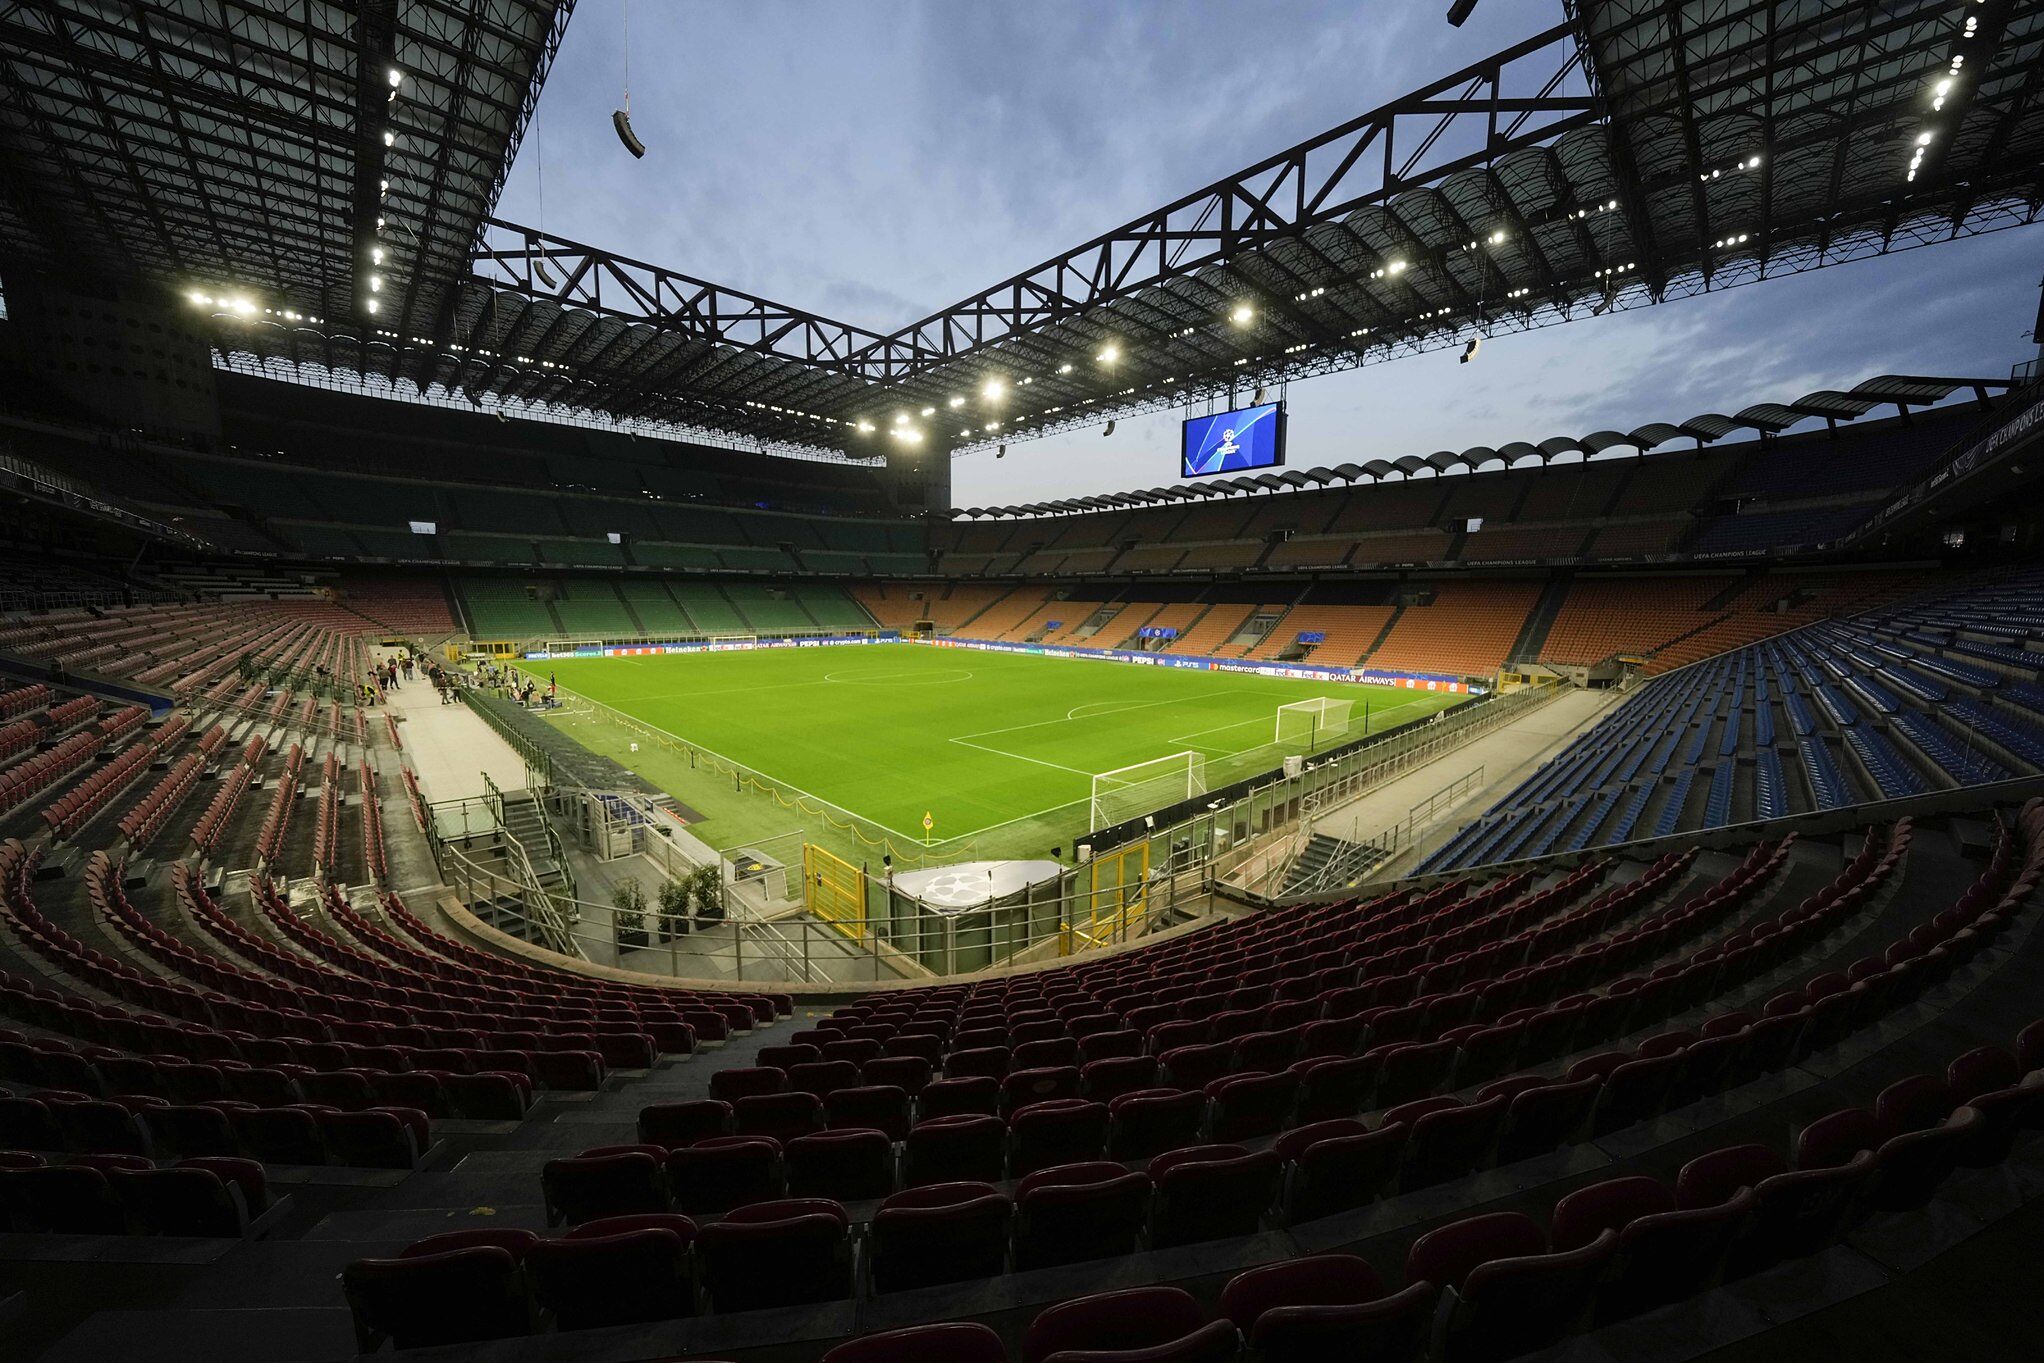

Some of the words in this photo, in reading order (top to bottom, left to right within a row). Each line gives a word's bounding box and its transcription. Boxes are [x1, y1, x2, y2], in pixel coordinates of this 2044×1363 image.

[1132, 656, 1154, 665] PEPSI
[1275, 669, 1295, 677] FedEx
[1302, 671, 1323, 679] FedEx
[1329, 673, 1356, 682] QATAR
[1359, 675, 1395, 686] AIRWAYS
